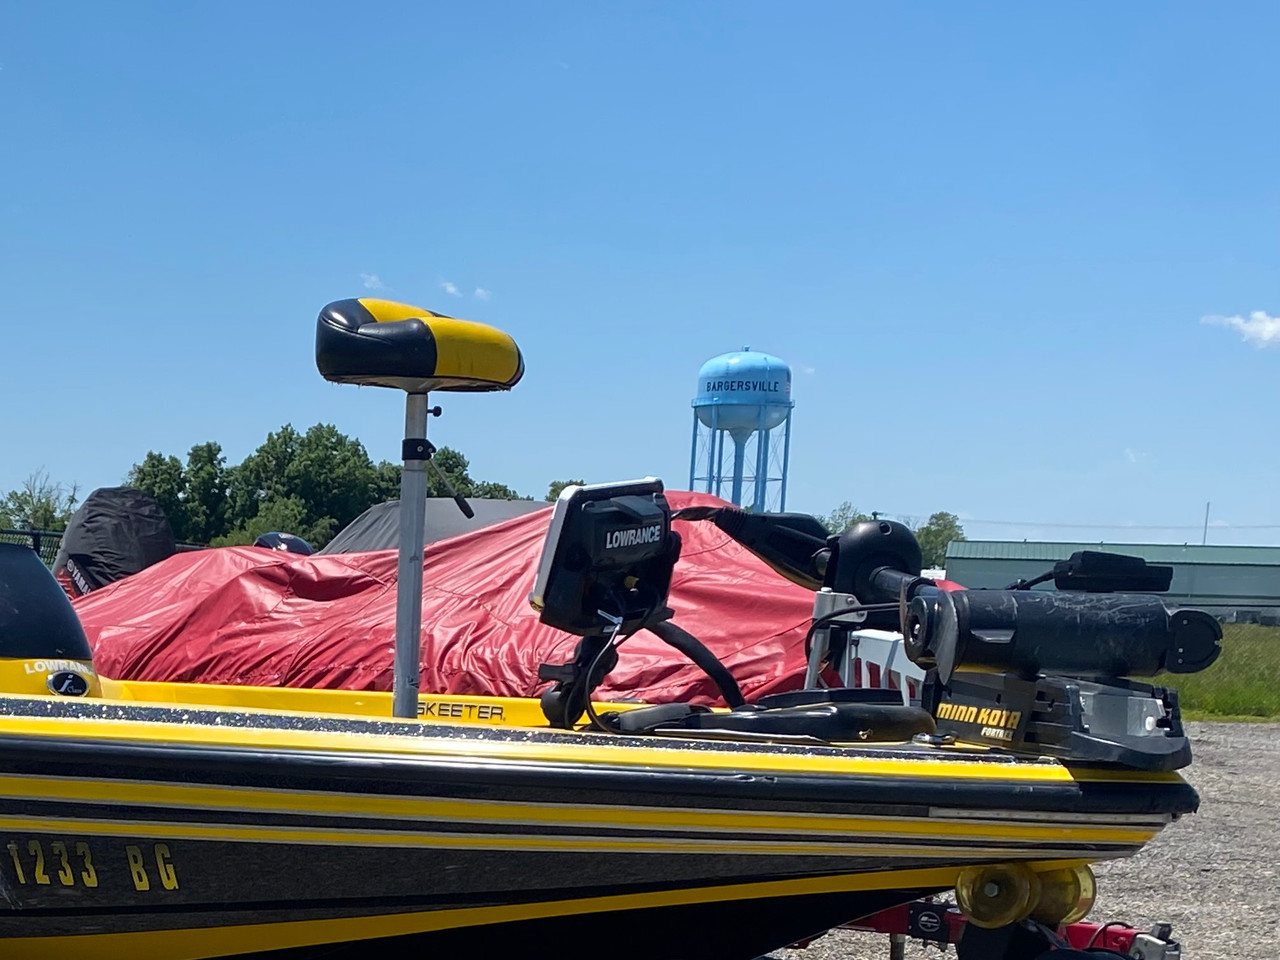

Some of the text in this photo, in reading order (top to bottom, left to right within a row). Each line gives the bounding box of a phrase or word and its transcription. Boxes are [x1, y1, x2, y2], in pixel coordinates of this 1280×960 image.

[706, 380, 780, 393] BARGERSVILLE
[605, 524, 661, 549] LOWRANCE
[24, 660, 95, 676] LOWRAN
[417, 702, 504, 721] SKEETER
[936, 703, 1021, 729] MINN KOTA
[6, 839, 99, 888] 1233
[125, 842, 180, 892] BG
